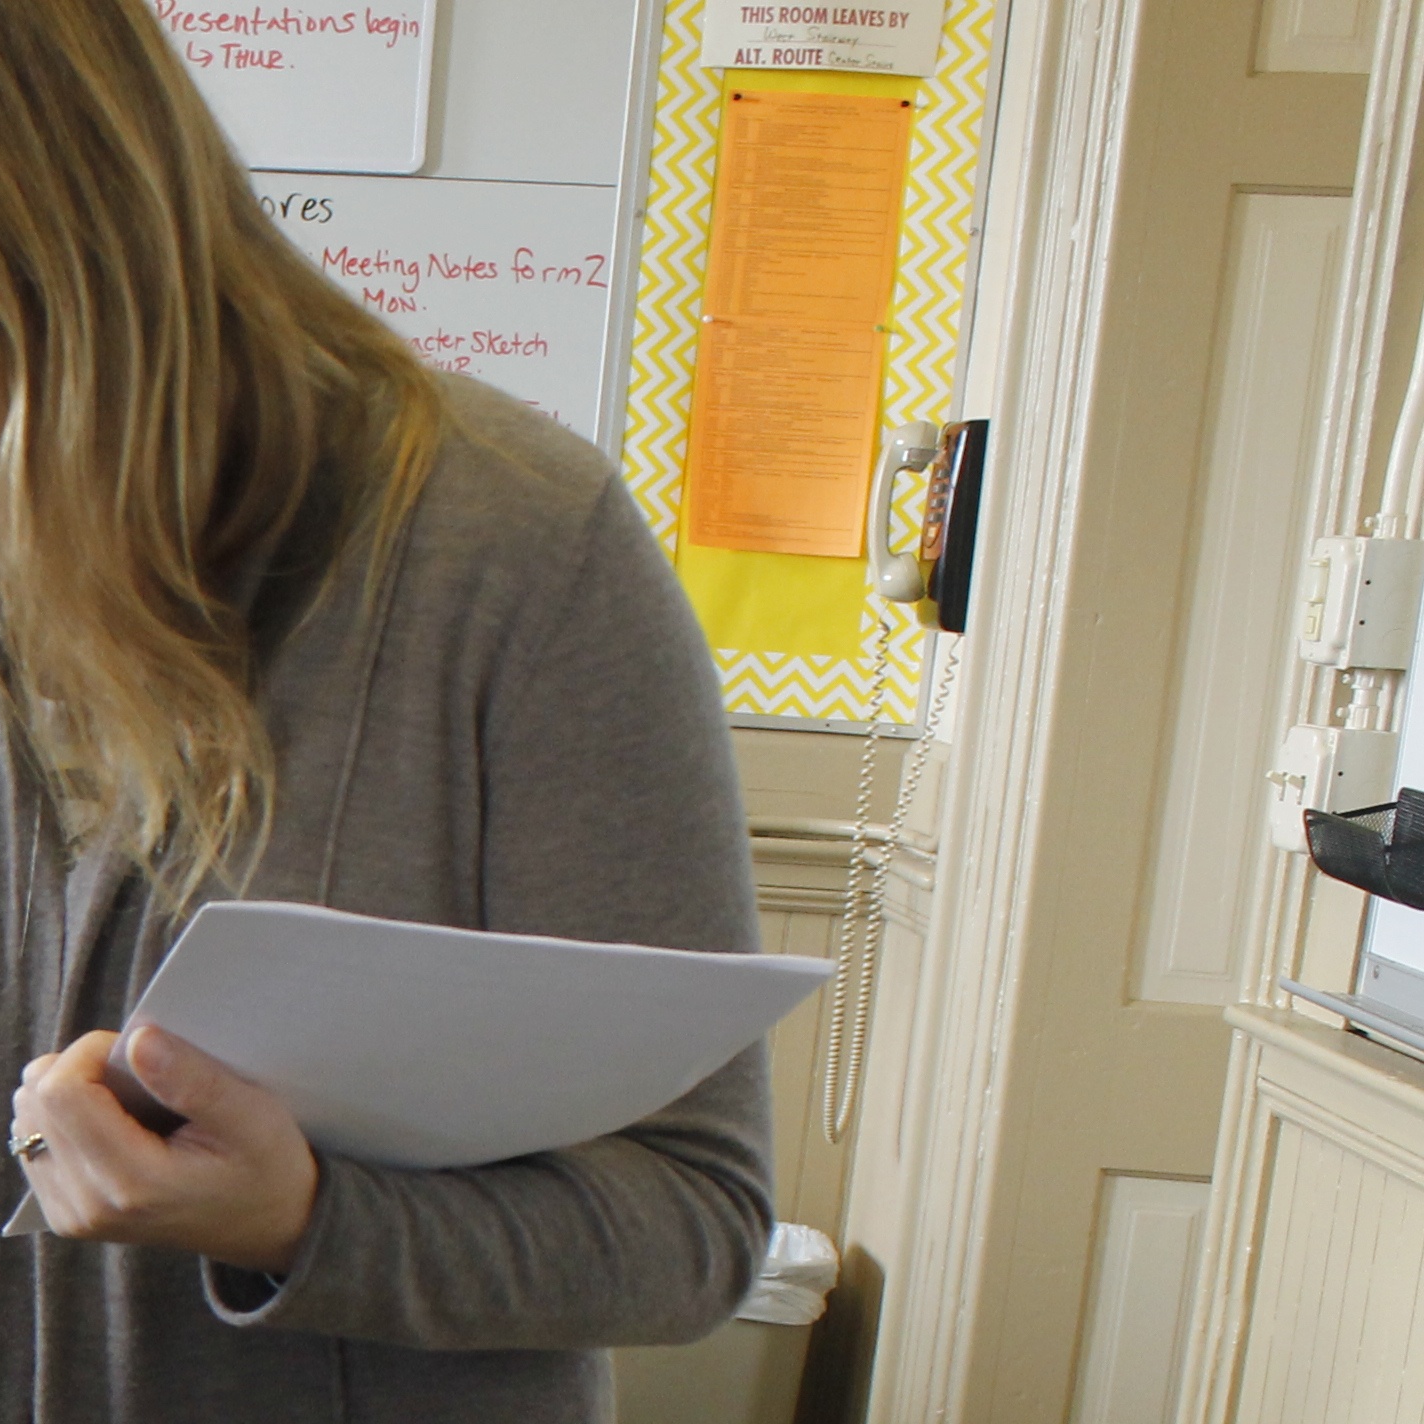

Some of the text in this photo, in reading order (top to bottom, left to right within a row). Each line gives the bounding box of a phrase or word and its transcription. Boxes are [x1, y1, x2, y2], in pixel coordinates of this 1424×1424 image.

[156, 0, 420, 48] Presentations begin
[741, 6, 910, 28] THIS ROOM LEAVES BY
[734, 48, 766, 65] ALT.
[772, 48, 823, 66] ROUTE
[257, 193, 333, 223] ores
[322, 246, 419, 294] Meeting
[426, 253, 498, 281] Notes
[409, 327, 548, 357] acter Sketch
